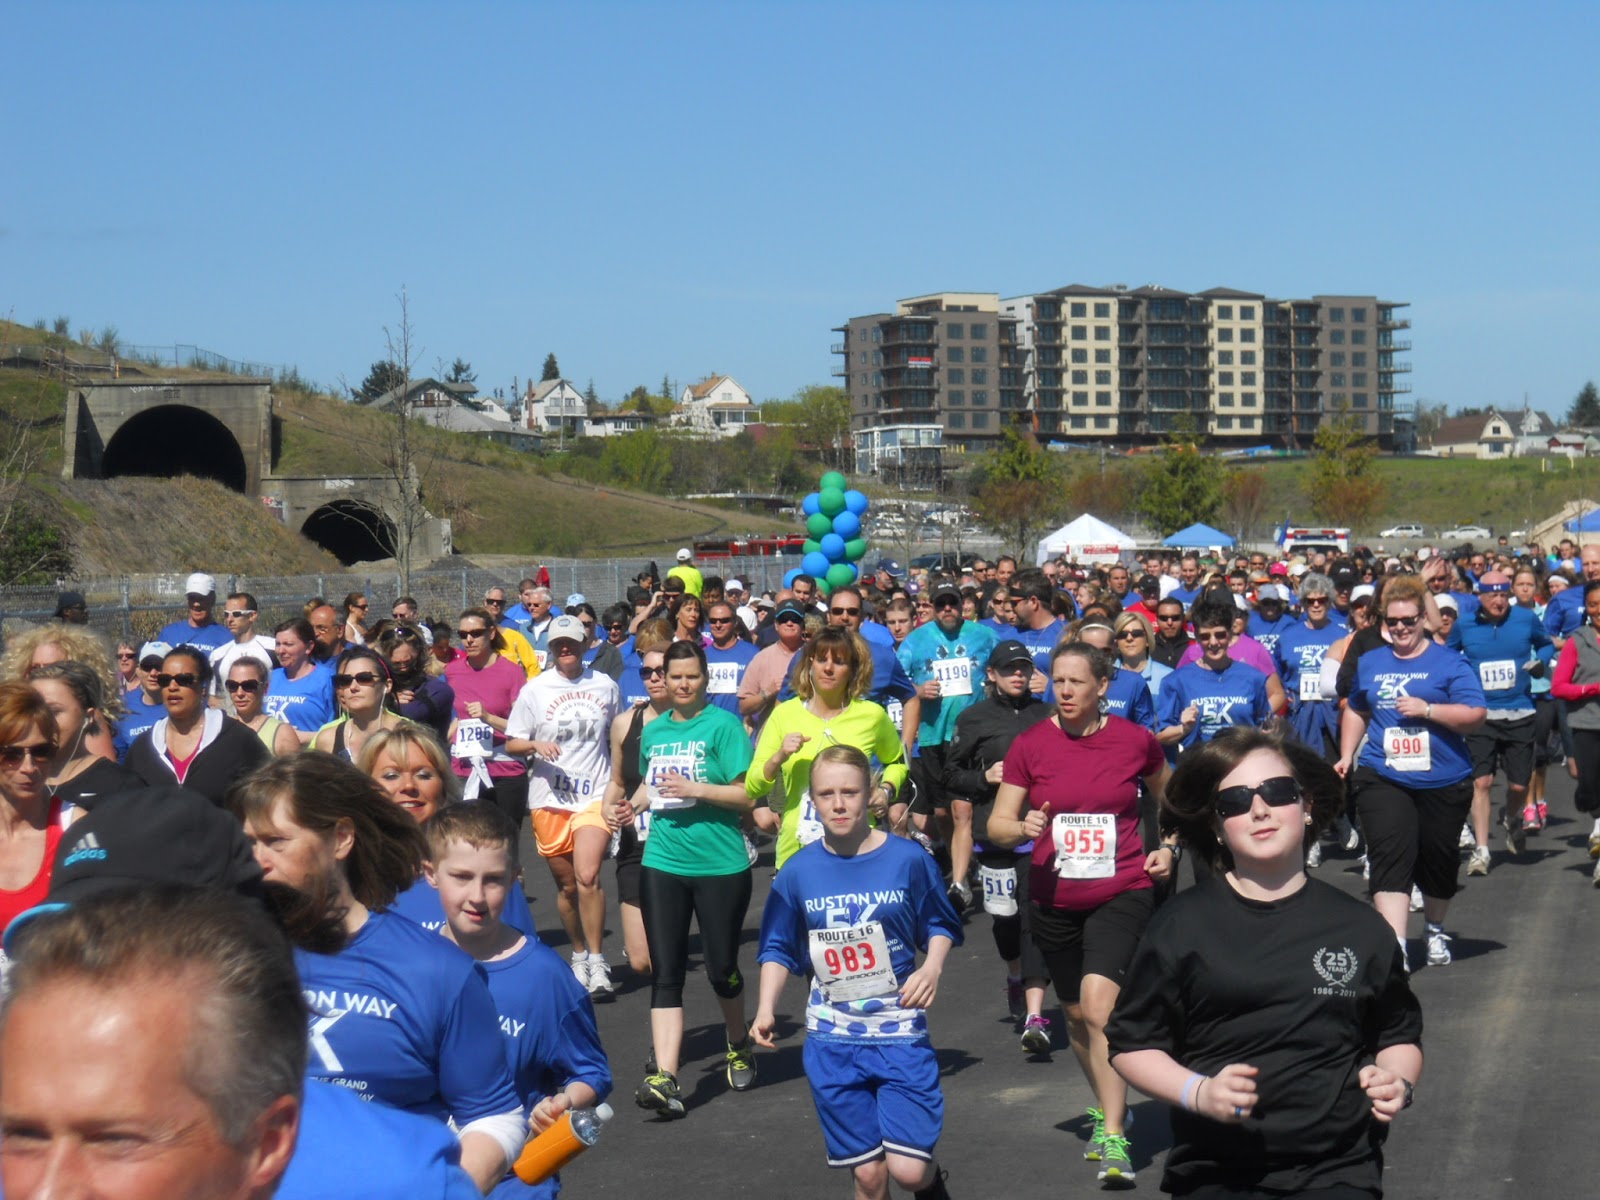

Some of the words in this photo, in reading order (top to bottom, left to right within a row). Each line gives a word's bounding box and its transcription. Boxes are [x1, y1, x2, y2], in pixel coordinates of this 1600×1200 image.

[1294, 644, 1322, 653] RUSTON
[1300, 649, 1326, 667] 5K
[708, 668, 735, 680] 1484
[937, 664, 969, 682] 1198
[1374, 673, 1408, 682] RUSTON
[1410, 672, 1429, 680] WAY
[1484, 667, 1514, 683] 1156
[1377, 679, 1411, 699] 5K
[263, 695, 287, 704] USTON
[289, 696, 306, 704] WAY
[1108, 699, 1127, 709] WAY
[1190, 696, 1229, 706] RUSTON
[1230, 696, 1248, 704] WAY
[266, 702, 290, 723] 5K
[1201, 702, 1233, 724] 5K
[129, 725, 153, 736] RUST
[556, 719, 599, 742] 5K
[669, 741, 706, 760] THIS
[1392, 737, 1422, 755] 990
[553, 774, 591, 796] 1516
[1060, 815, 1093, 824] ROUTE
[1096, 816, 1109, 825] 16
[1064, 829, 1105, 854] 955
[805, 892, 870, 914] RUSTON
[873, 890, 905, 905] WAY
[817, 929, 855, 942] ROUTE
[858, 925, 874, 937] 16
[824, 942, 876, 976] 983
[1325, 952, 1347, 967] 25
[845, 967, 887, 981] BROOKS
[1327, 965, 1348, 973] YEARS
[343, 992, 398, 1019] WAY
[498, 1015, 526, 1037] AY
[308, 1008, 348, 1072] K
[331, 1077, 368, 1090] GRAND
